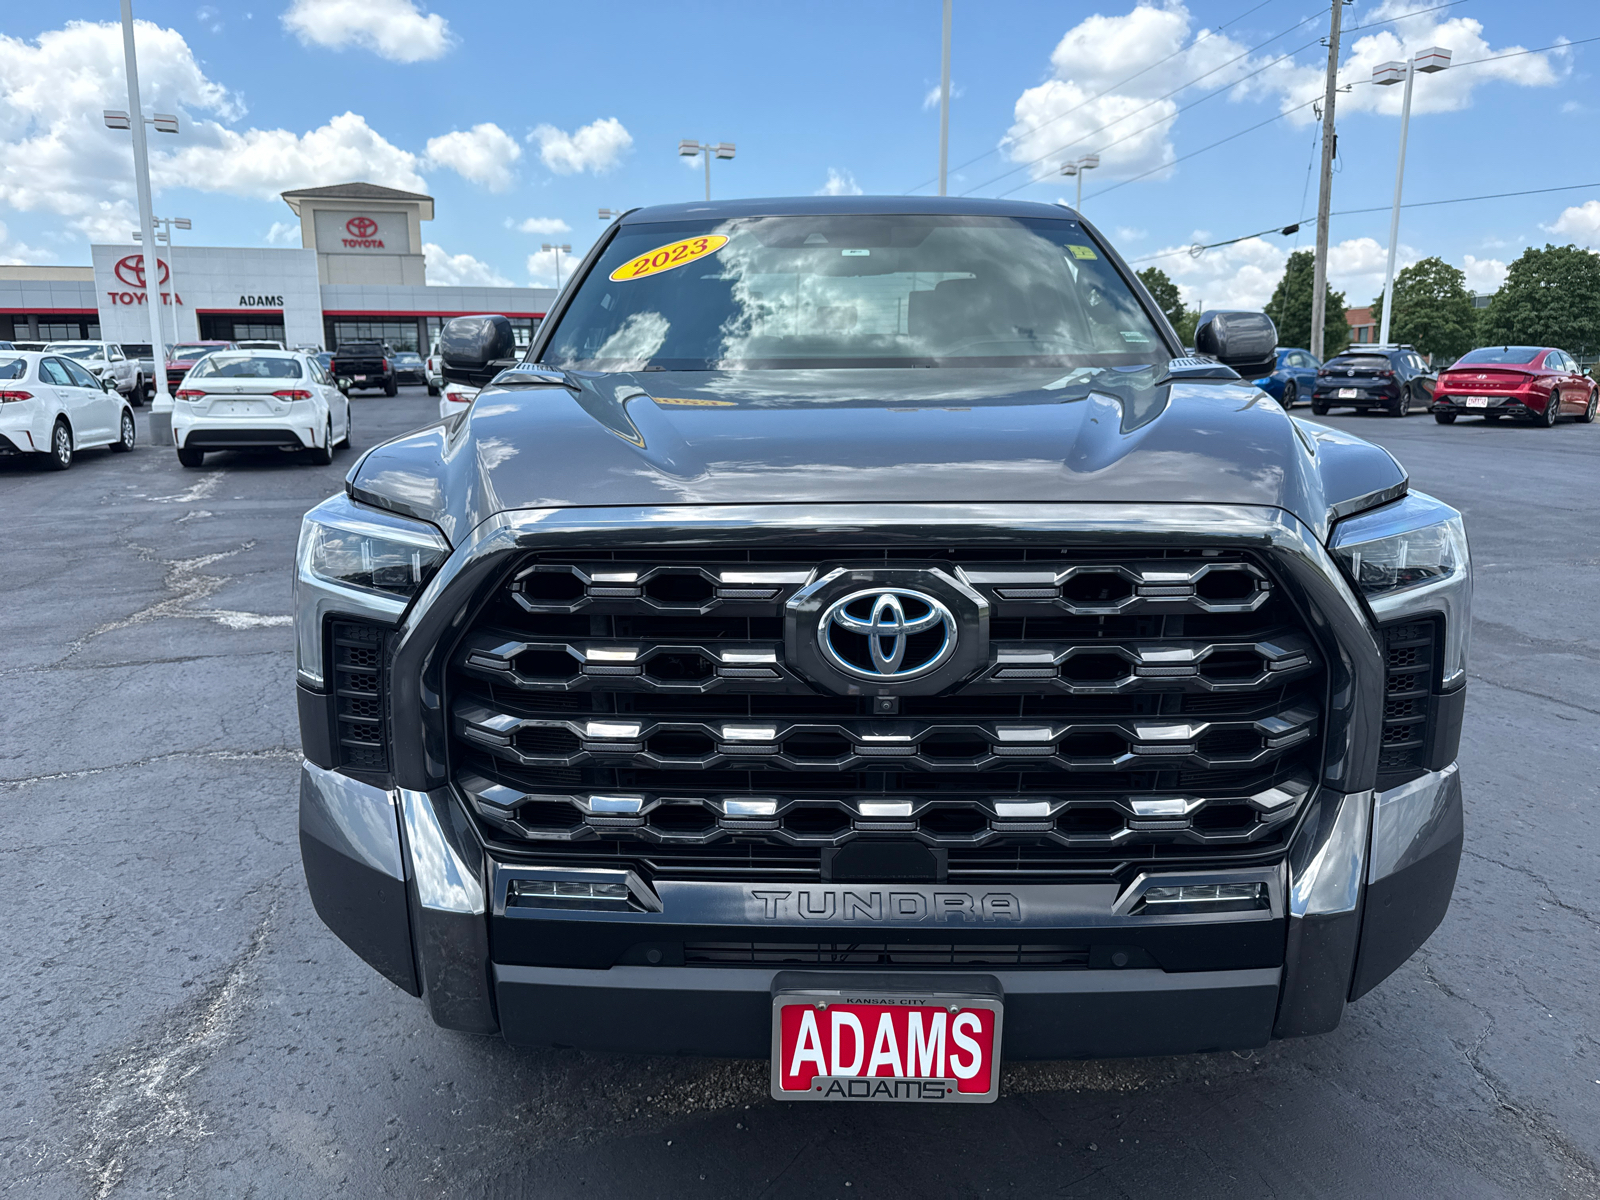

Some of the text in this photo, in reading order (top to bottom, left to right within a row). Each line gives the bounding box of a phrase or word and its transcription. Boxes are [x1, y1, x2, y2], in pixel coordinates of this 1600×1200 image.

[341, 238, 385, 249] TOYOTA
[632, 238, 709, 277] 2023
[107, 292, 183, 306] TOYTA
[239, 295, 284, 306] ADAMS
[751, 891, 1022, 922] TUNDRA
[789, 1009, 983, 1079] ADAMS
[824, 1080, 945, 1099] ADAMS
